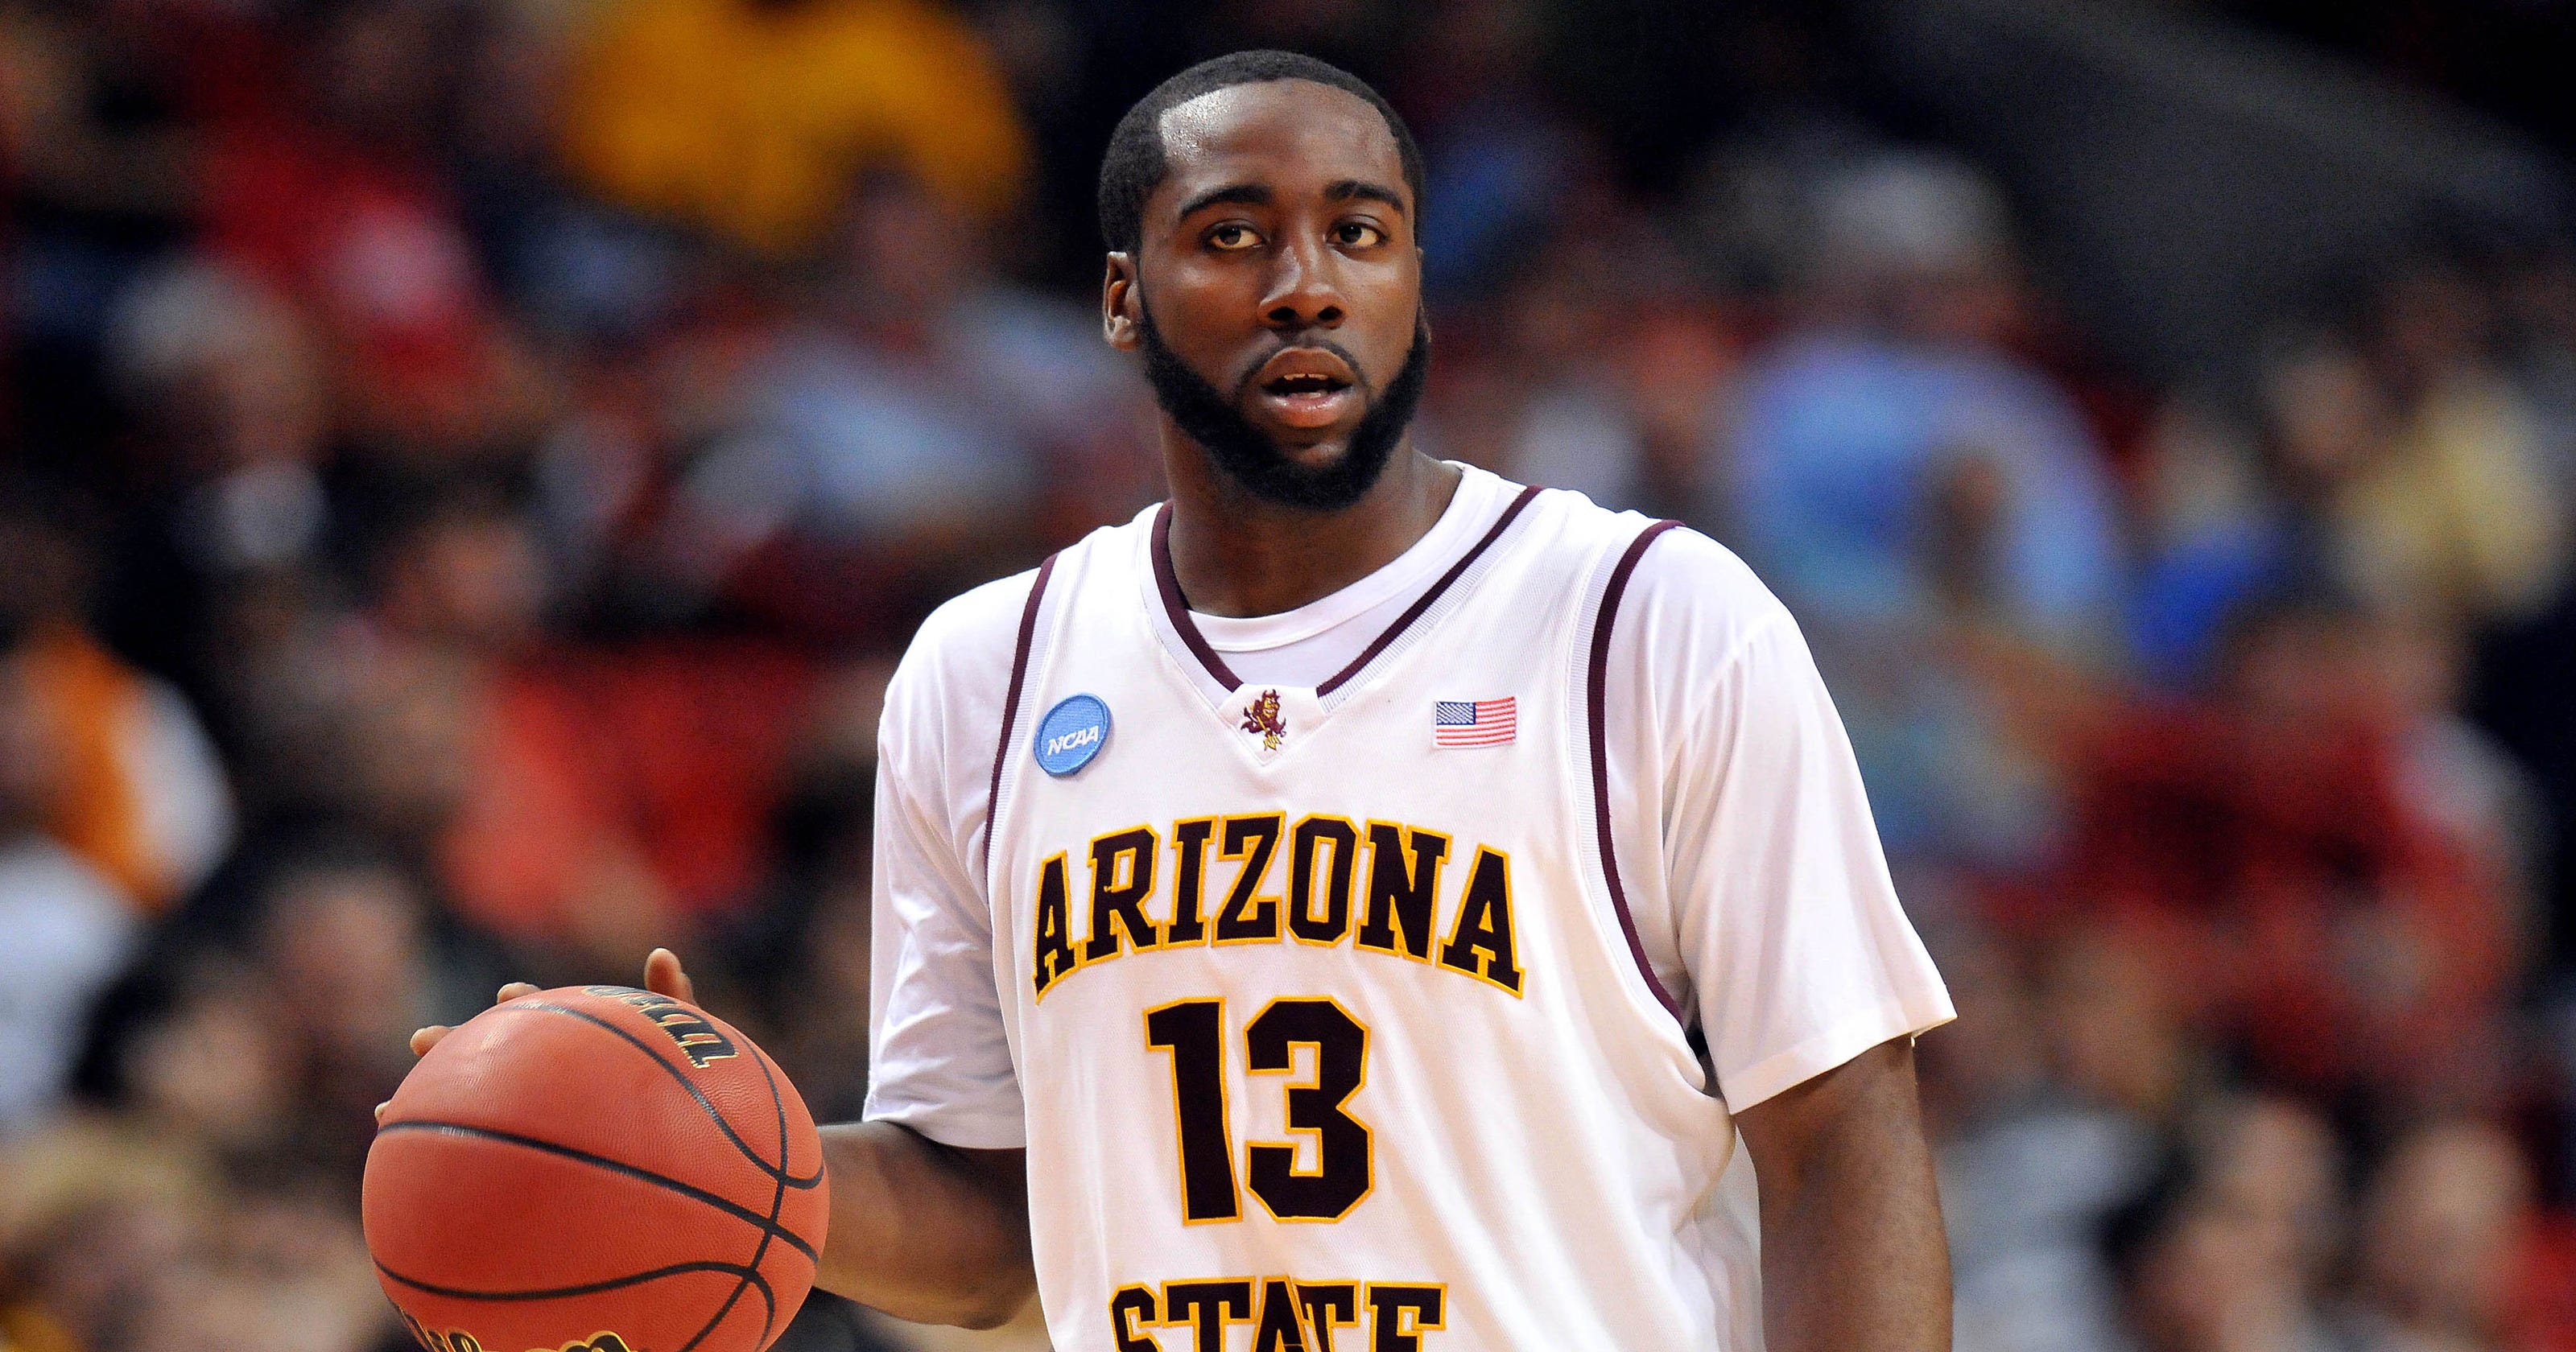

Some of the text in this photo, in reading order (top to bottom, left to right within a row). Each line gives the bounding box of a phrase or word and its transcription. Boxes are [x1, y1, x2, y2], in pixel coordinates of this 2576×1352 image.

[1047, 725, 1099, 756] NCAA
[1033, 811, 1525, 1004] ARIZONA
[1143, 995, 1375, 1226] 13
